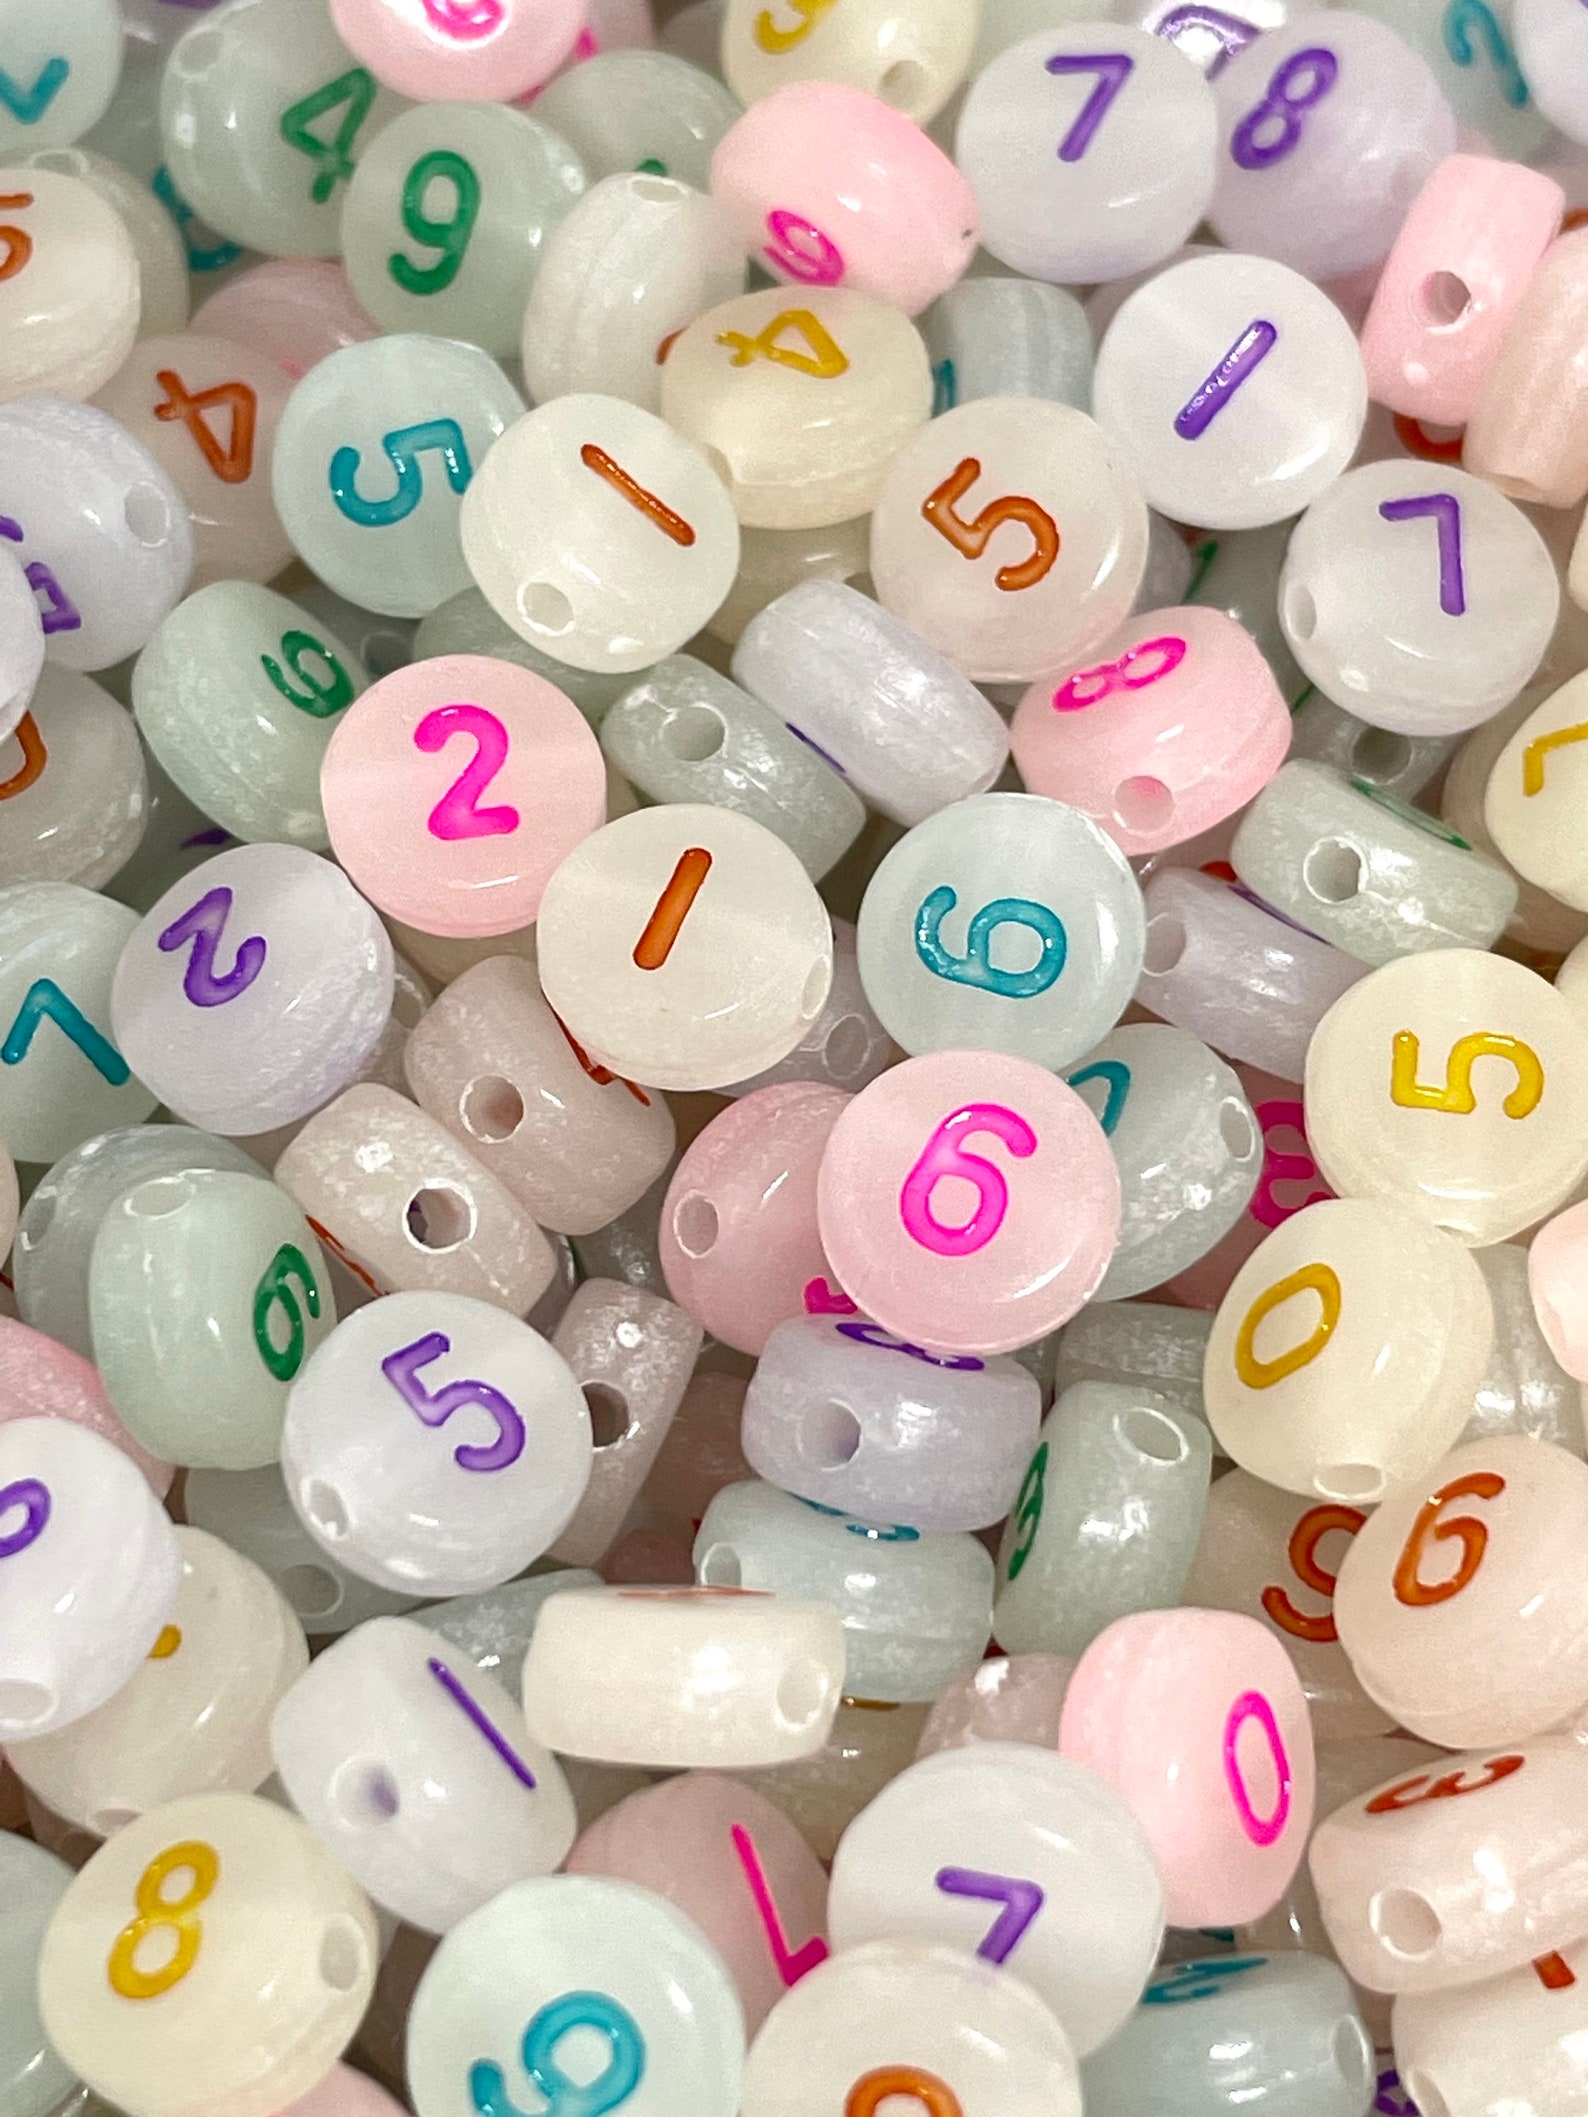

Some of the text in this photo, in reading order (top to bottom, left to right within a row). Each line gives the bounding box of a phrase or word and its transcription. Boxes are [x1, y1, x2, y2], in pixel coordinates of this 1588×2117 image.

[281, 68, 376, 203] 4
[1046, 53, 1134, 162] 7
[1230, 46, 1339, 170] 8
[388, 150, 481, 295] 9
[715, 307, 850, 379] 4
[1174, 319, 1278, 441] 1
[154, 369, 257, 484] 4
[329, 417, 472, 527] 5
[580, 443, 696, 547] 1
[922, 456, 1060, 591] 5
[1379, 493, 1466, 616] 7
[1051, 635, 1188, 713] 8
[413, 703, 521, 841] 2
[157, 886, 267, 1007] 2
[632, 847, 713, 970] 1
[1390, 1029, 1546, 1120] 5
[899, 1102, 1038, 1257] 6
[1234, 1262, 1342, 1390] 0
[381, 1331, 527, 1472] 5
[1392, 1471, 1507, 1608] 6
[428, 1658, 536, 1789] 1
[1222, 1689, 1292, 1848] 0
[107, 1839, 221, 2001] 8
[934, 1865, 1045, 1966] 7
